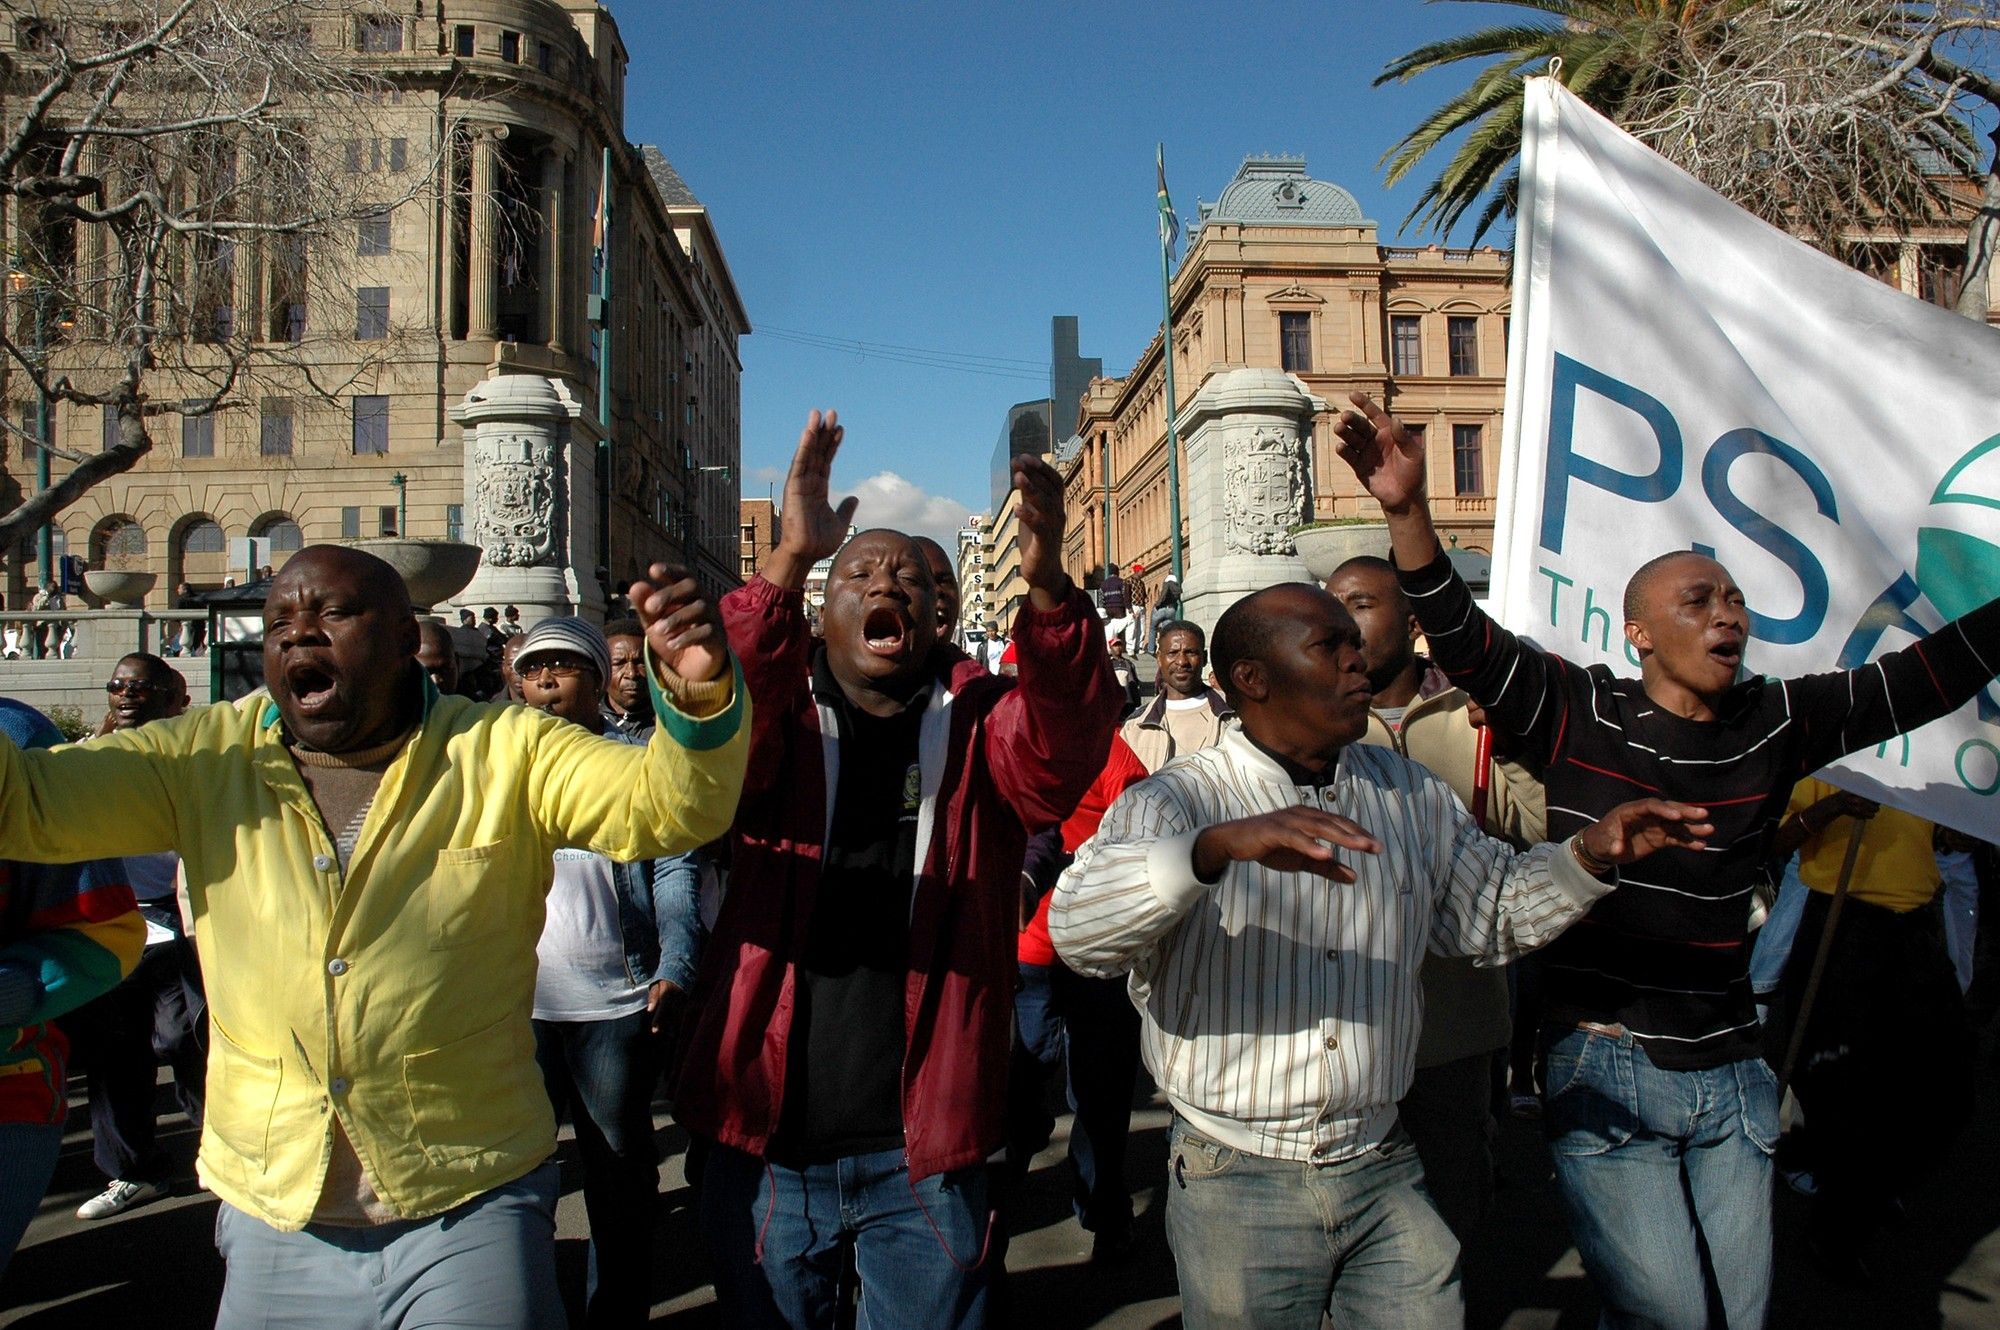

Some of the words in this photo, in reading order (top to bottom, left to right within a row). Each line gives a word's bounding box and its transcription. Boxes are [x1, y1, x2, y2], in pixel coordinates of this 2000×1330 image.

[974, 535, 983, 622] LESAK
[1539, 351, 2000, 728] PSA
[554, 852, 593, 862] Choice
